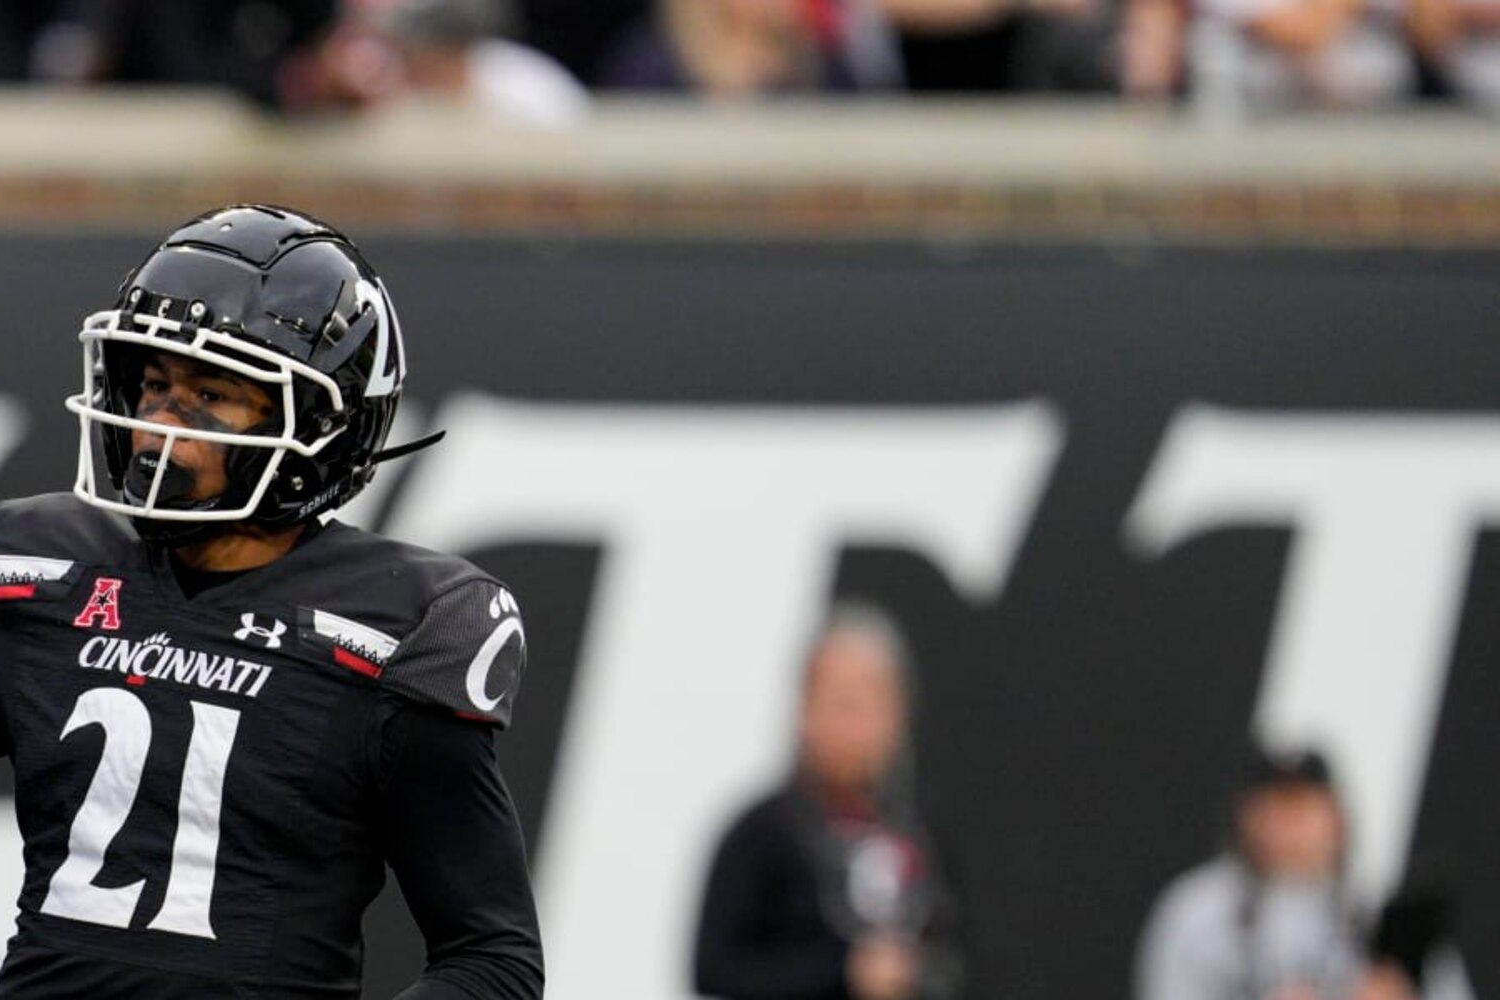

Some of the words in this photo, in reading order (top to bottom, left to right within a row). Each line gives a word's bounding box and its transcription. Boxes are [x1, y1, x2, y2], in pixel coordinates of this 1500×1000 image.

[73, 577, 122, 630] A
[78, 634, 273, 697] CINCINNATI
[40, 687, 241, 940] 21
